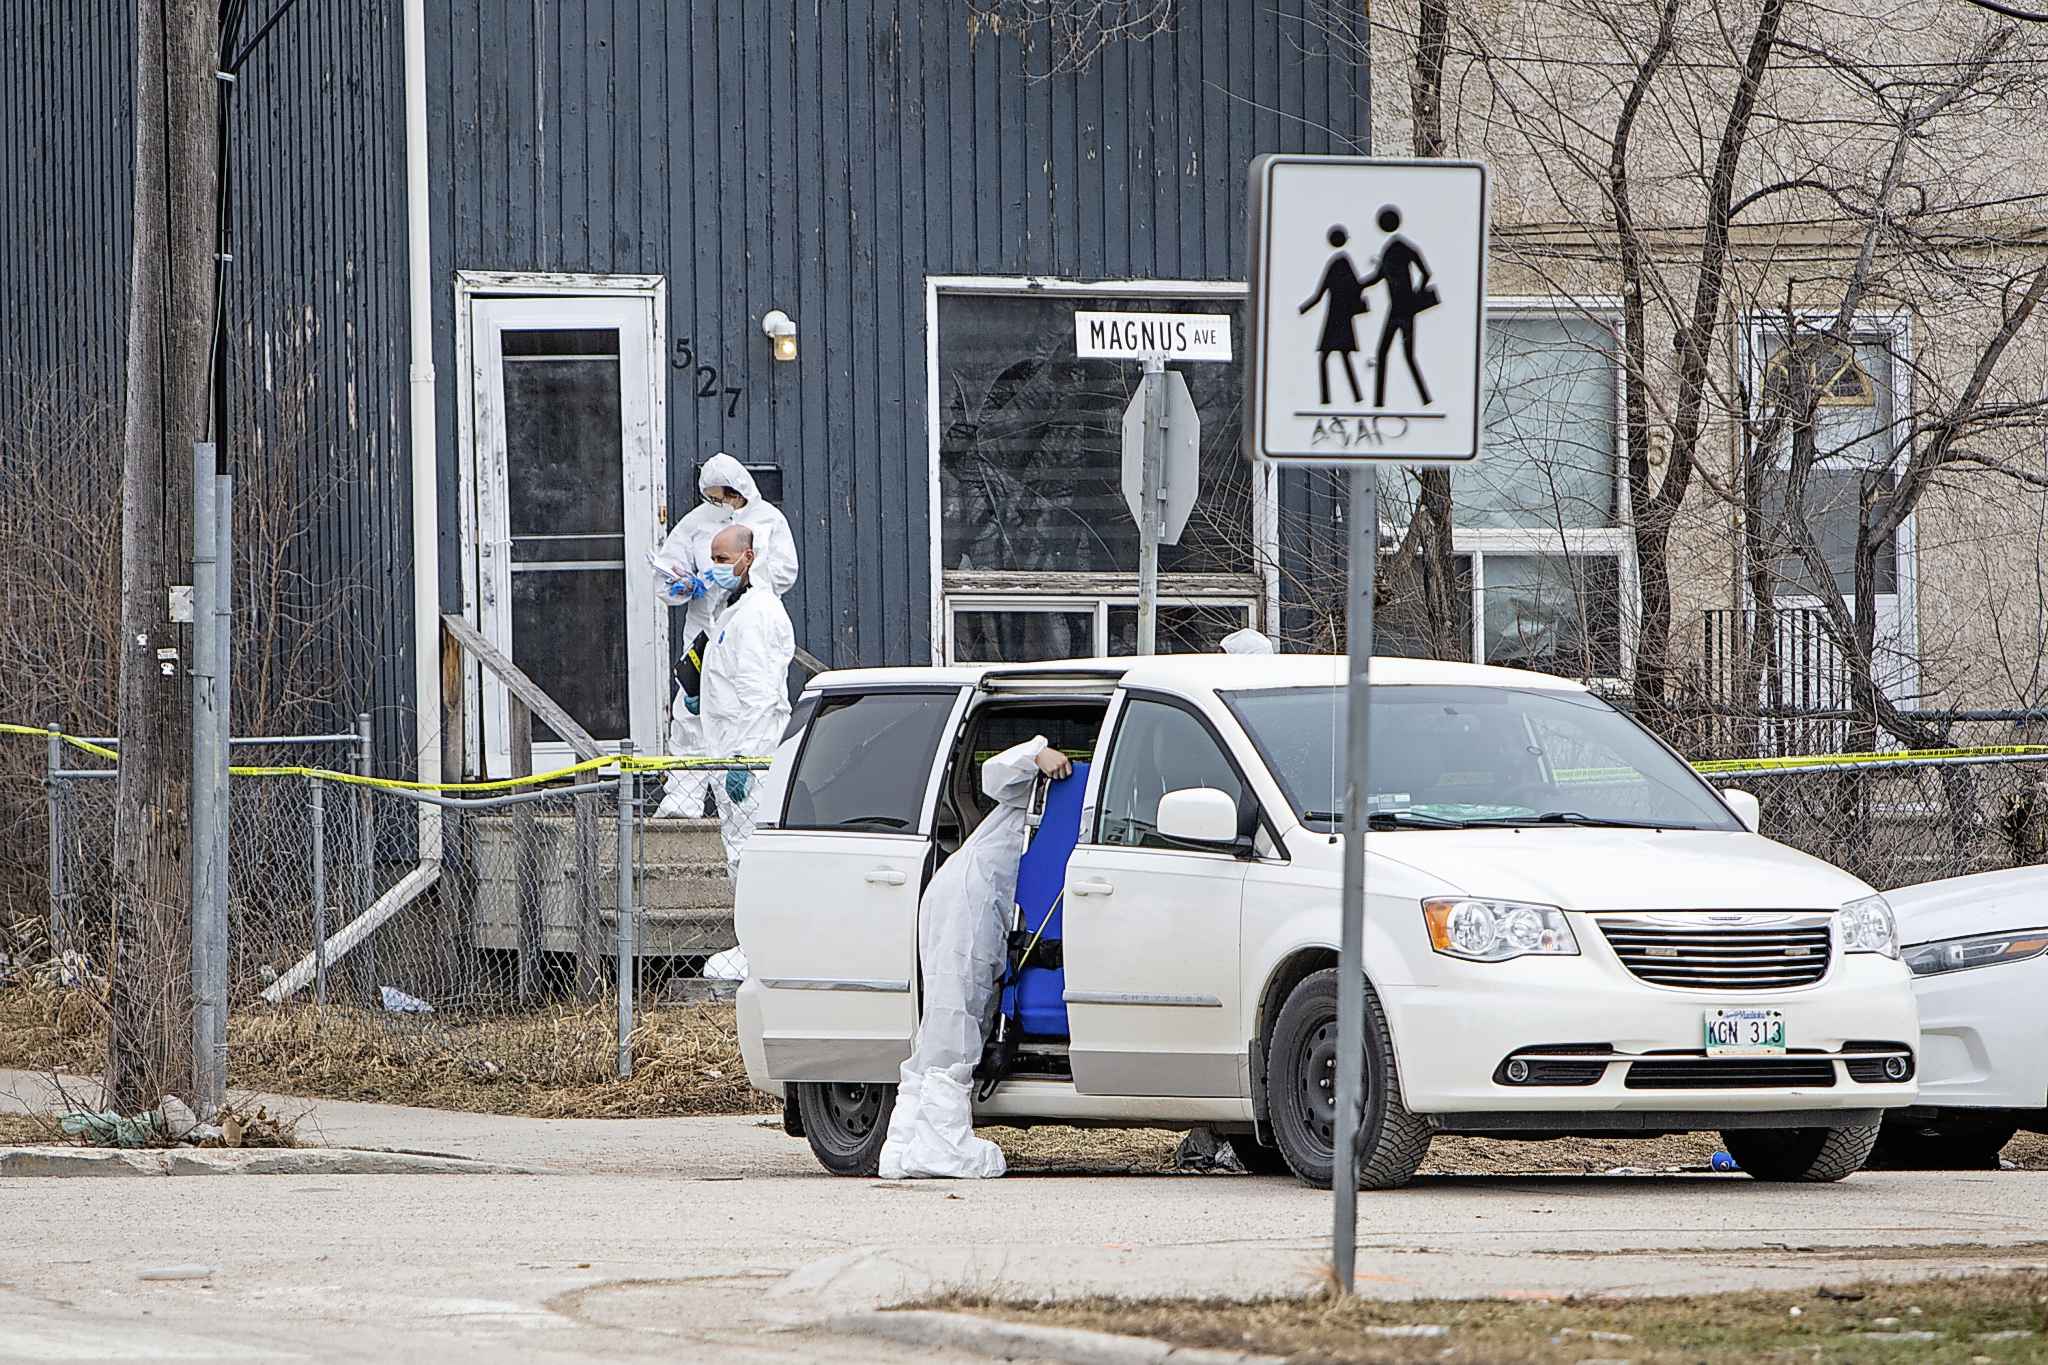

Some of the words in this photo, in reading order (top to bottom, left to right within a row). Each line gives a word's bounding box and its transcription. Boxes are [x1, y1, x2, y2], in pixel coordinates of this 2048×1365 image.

[1090, 320, 1187, 351] MAGNUS
[1193, 329, 1217, 345] AVE
[671, 337, 742, 418] 527
[1708, 1020, 1738, 1045] KGN
[1750, 1020, 1782, 1044] 313
